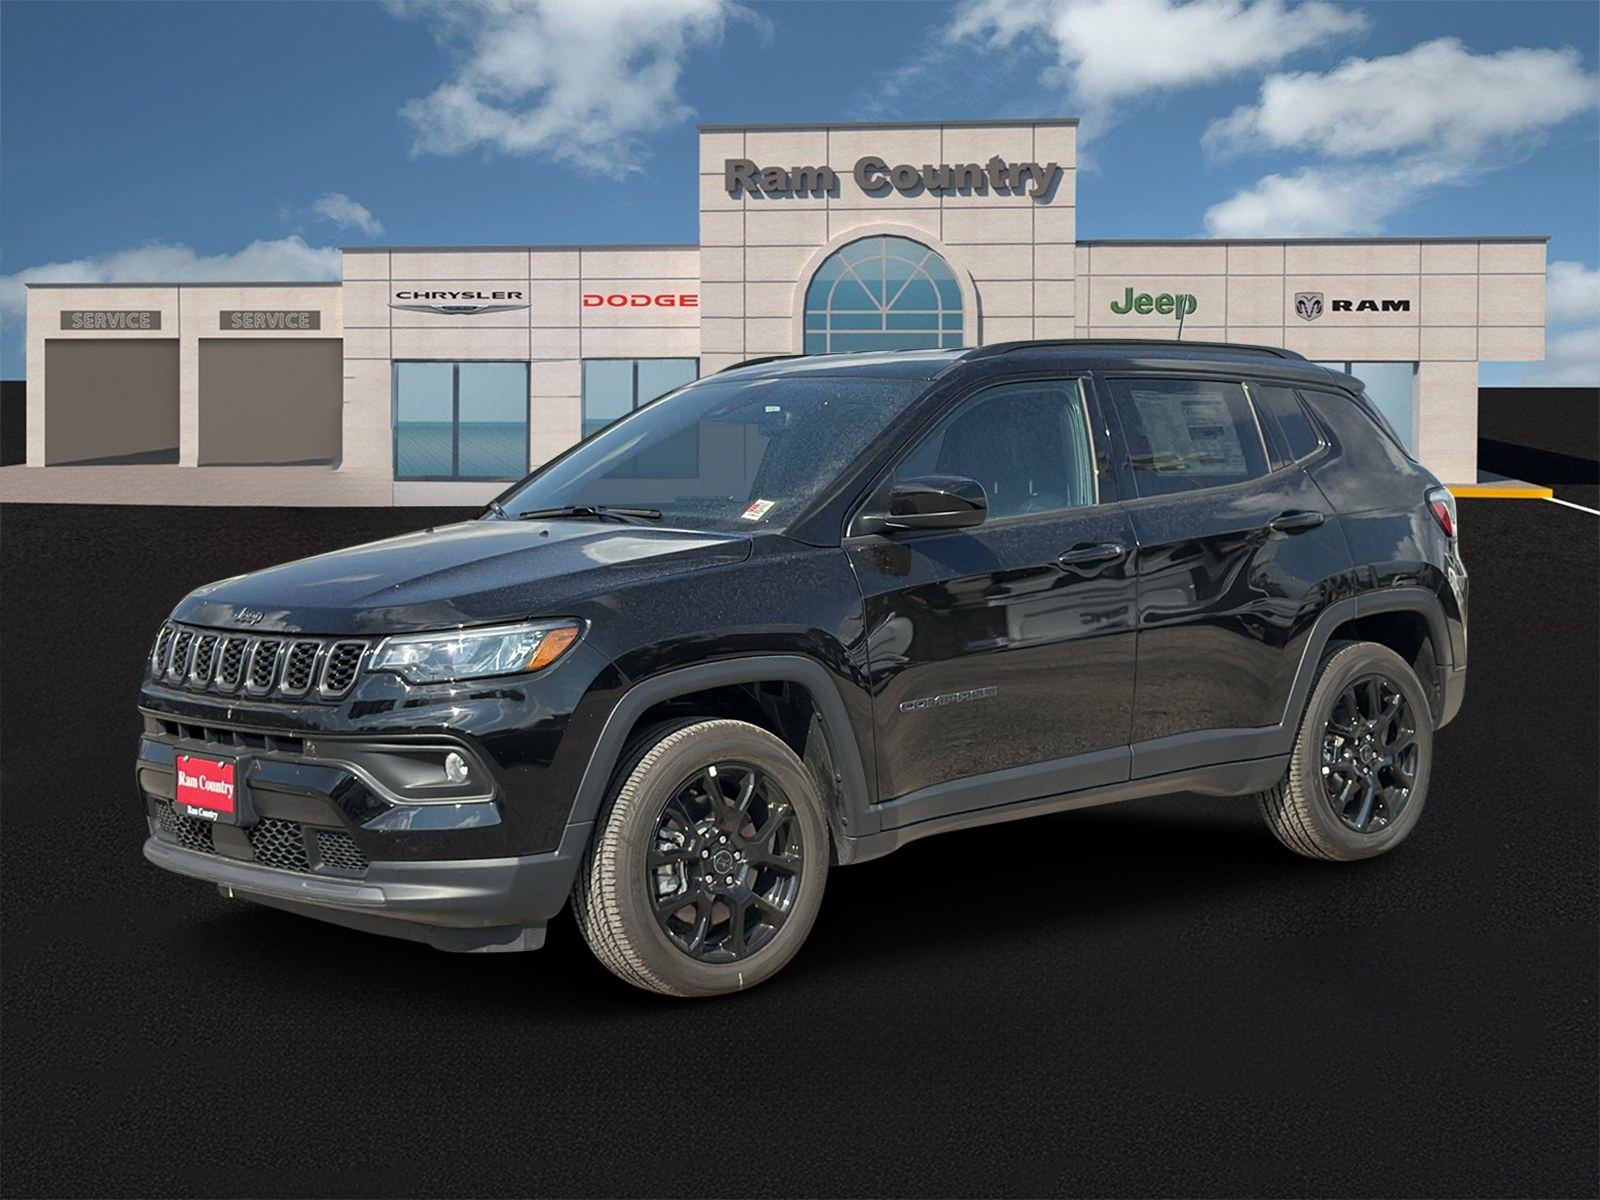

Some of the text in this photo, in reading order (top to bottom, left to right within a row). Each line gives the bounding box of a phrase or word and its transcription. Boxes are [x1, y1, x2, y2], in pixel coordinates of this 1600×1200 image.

[724, 154, 1058, 198] Ram Country
[395, 291, 523, 300] CHRYSLER
[583, 294, 699, 307] DODGE
[1110, 287, 1198, 320] Jeep
[1331, 299, 1411, 312] RAM
[71, 312, 151, 329] SERVICE
[231, 312, 311, 329] SERVICE
[178, 771, 234, 798] Ram Country
[188, 805, 218, 820] Ram Country
